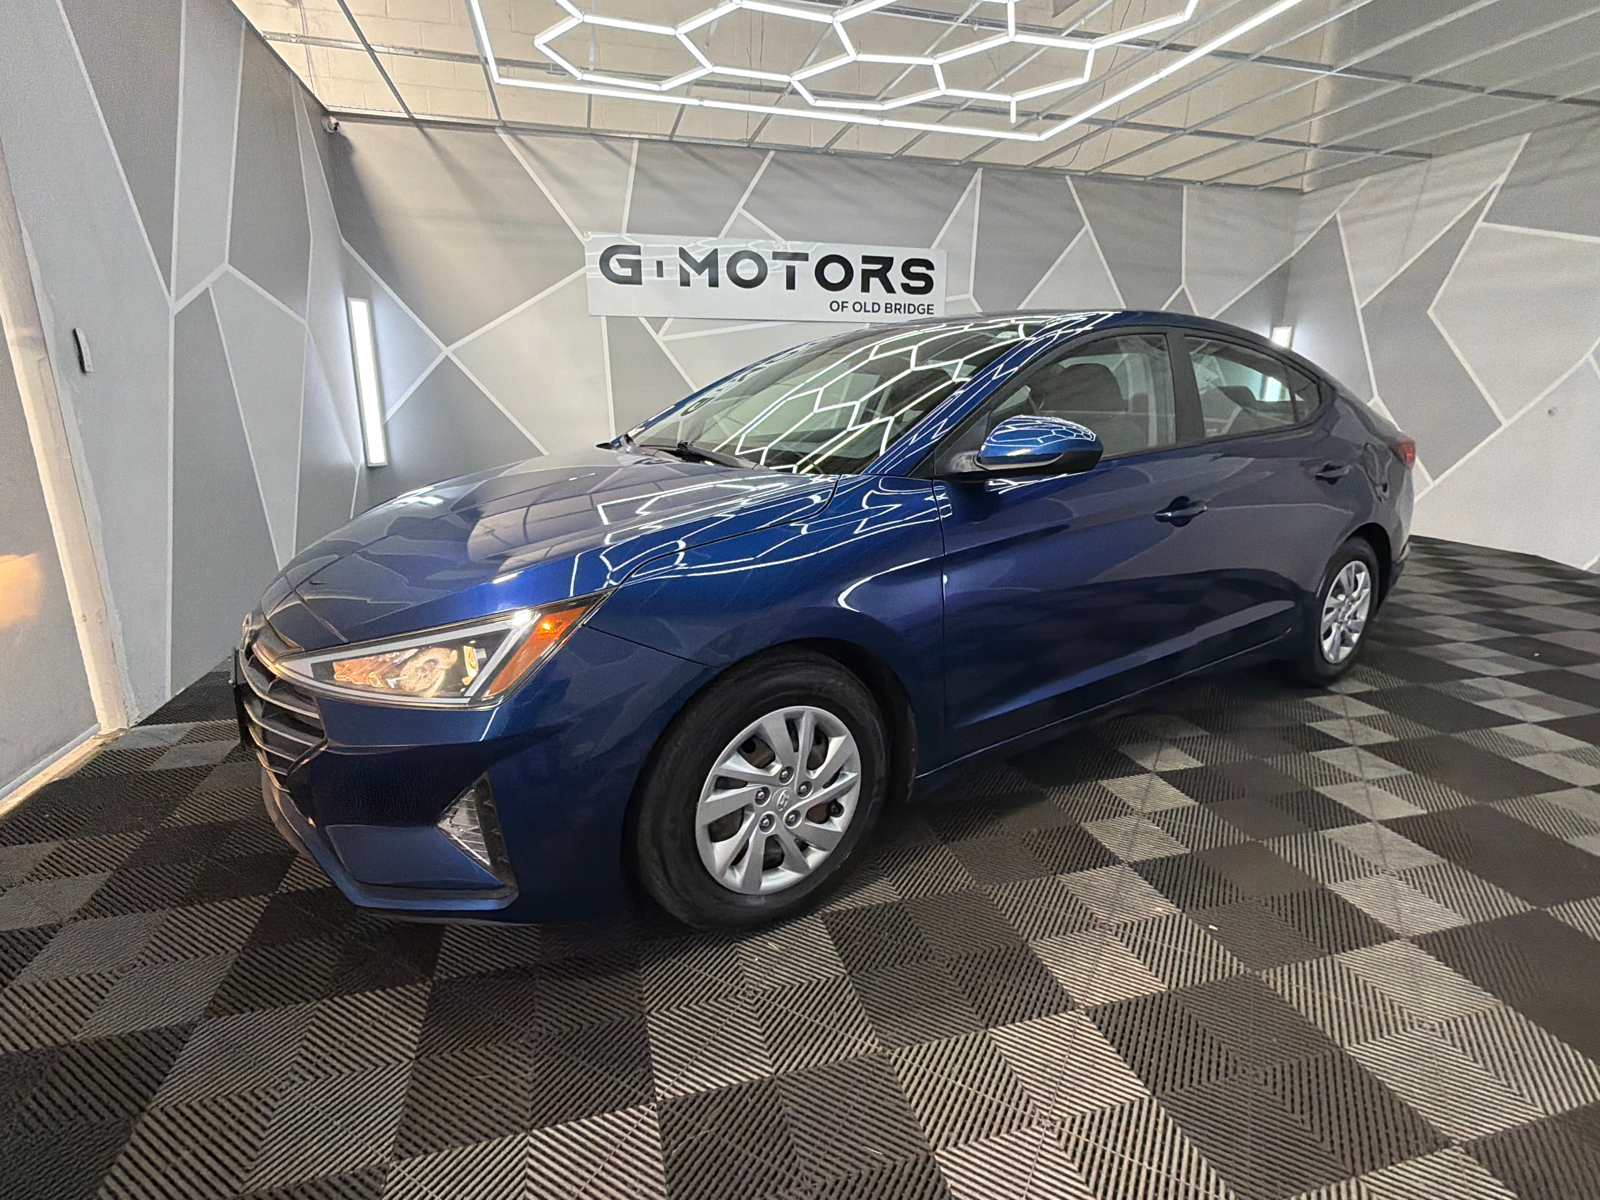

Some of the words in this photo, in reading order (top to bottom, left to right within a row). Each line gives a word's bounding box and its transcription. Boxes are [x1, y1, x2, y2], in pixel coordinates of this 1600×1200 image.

[829, 300, 849, 313] OF
[852, 301, 881, 314] OLD
[884, 302, 935, 315] BRIDGE
